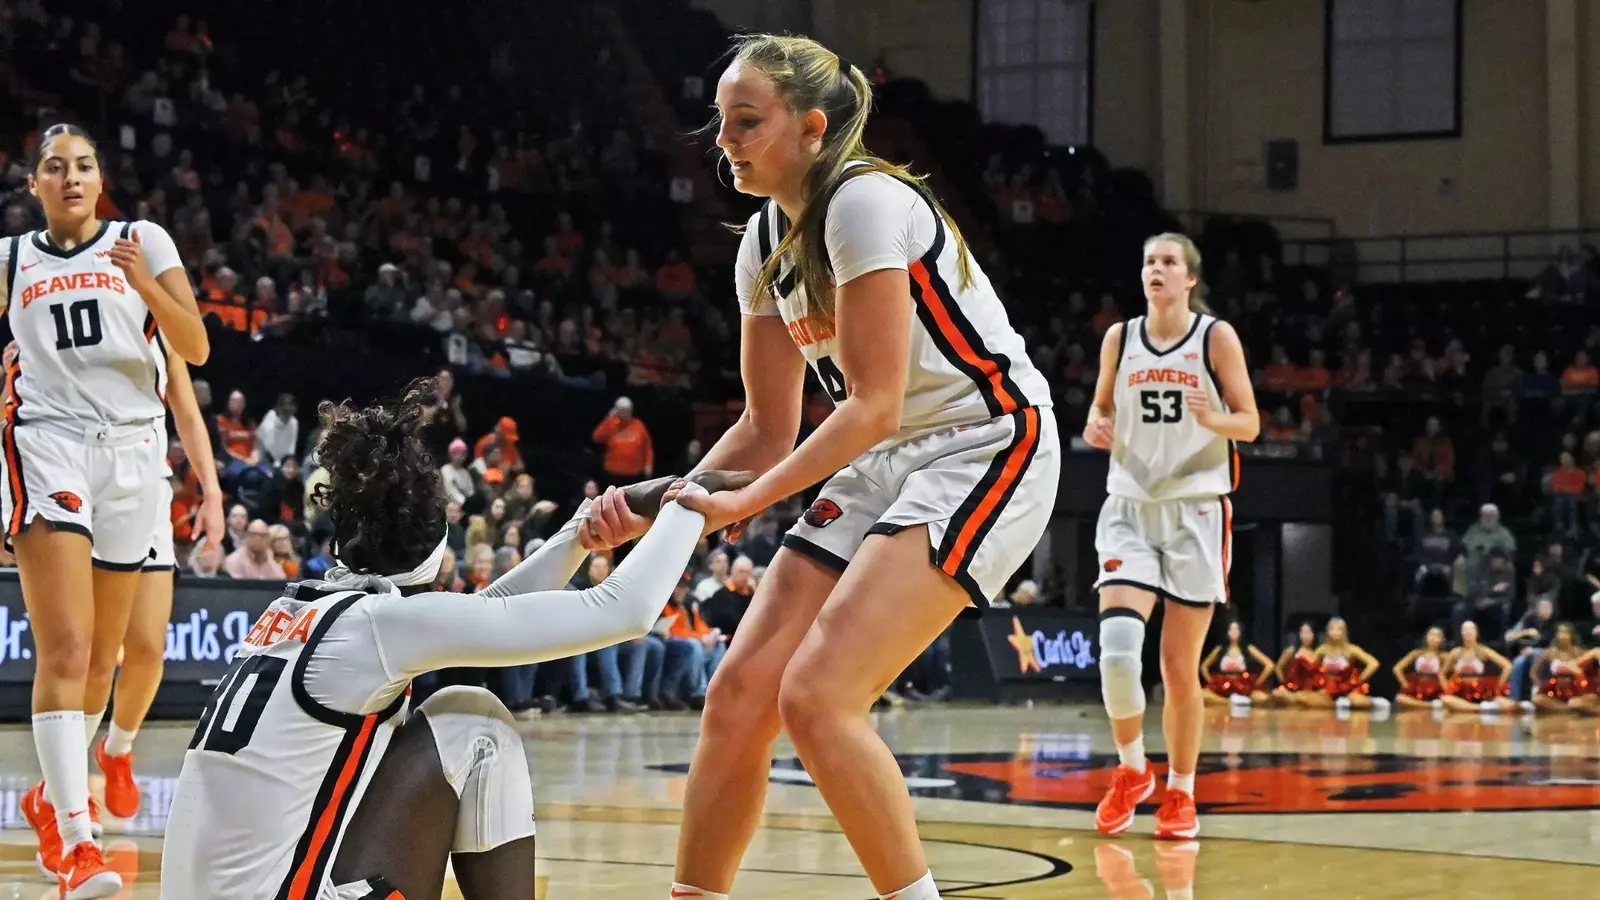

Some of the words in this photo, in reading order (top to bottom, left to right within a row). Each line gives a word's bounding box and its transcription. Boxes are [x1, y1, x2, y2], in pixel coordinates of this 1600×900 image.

[21, 272, 125, 309] BEAVERS
[49, 298, 103, 350] 10
[1128, 368, 1199, 388] BEAVERS
[1140, 390, 1182, 423] 53
